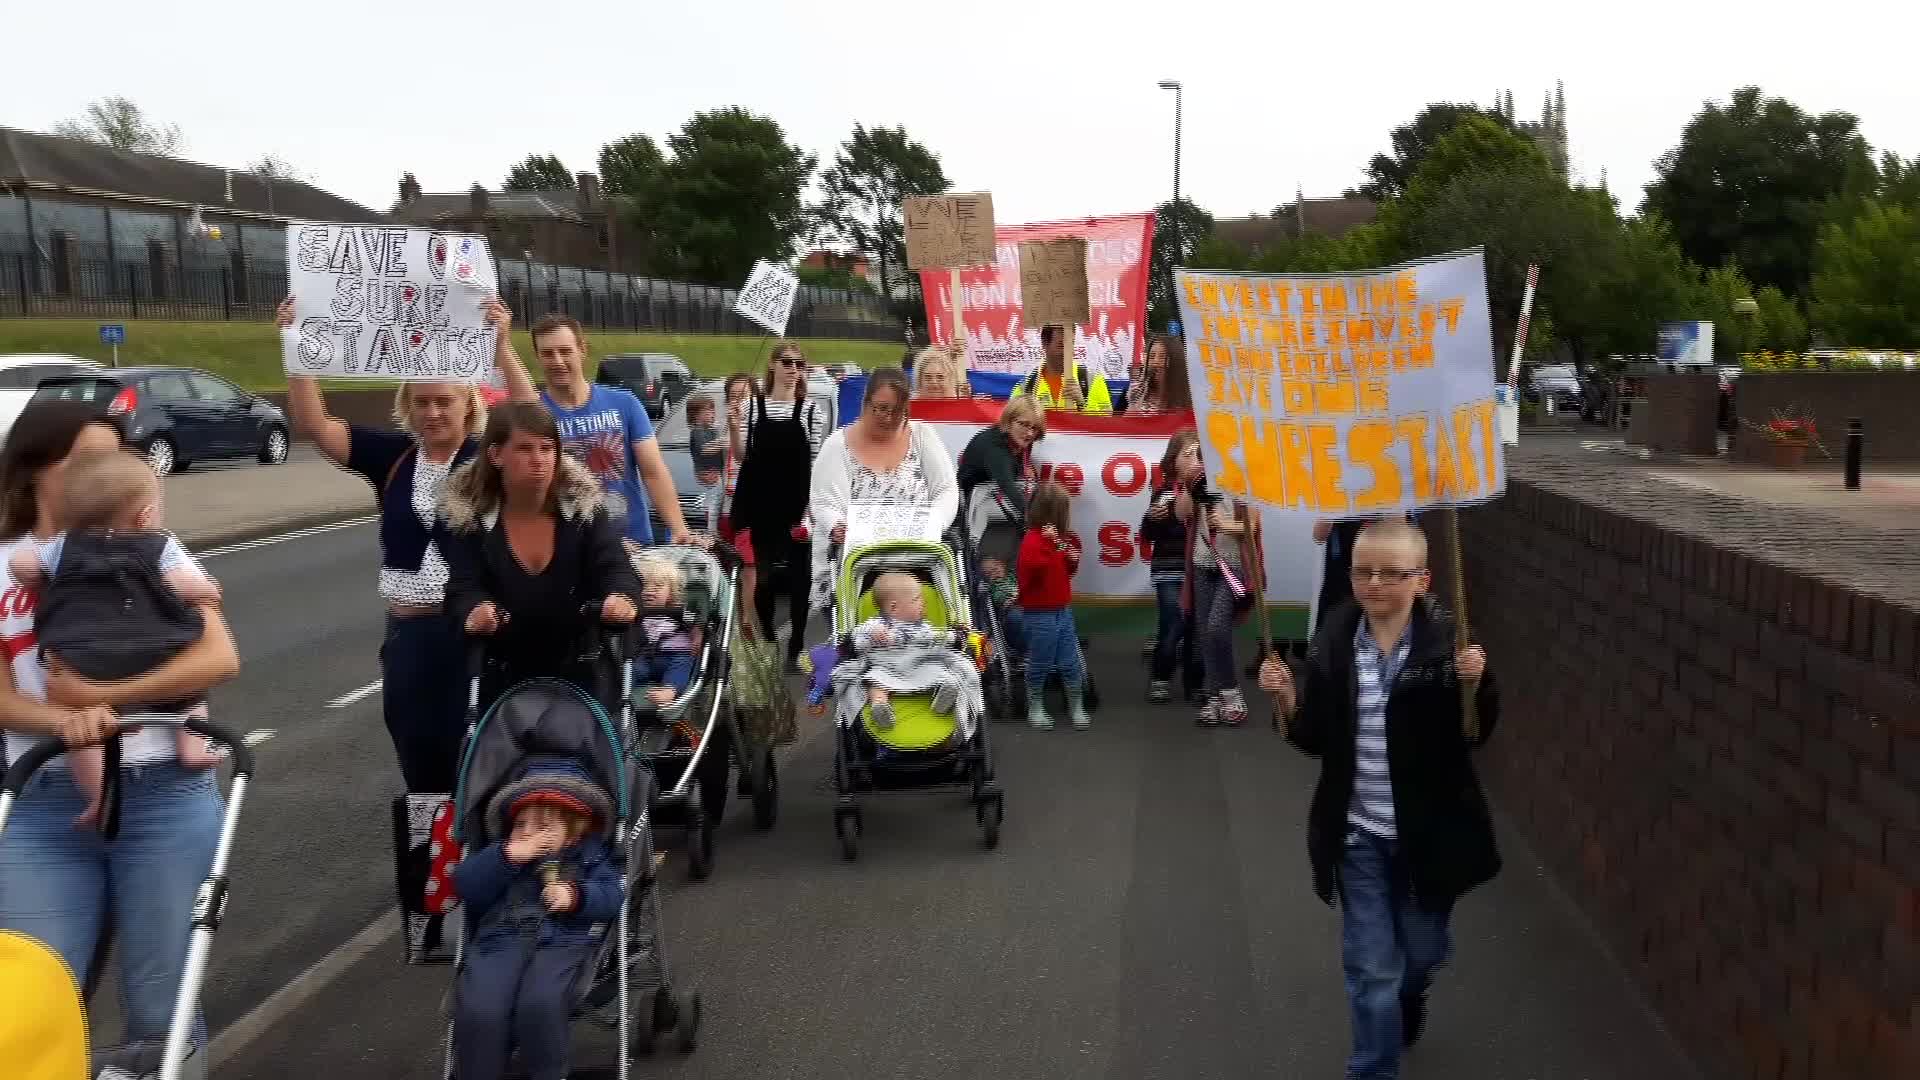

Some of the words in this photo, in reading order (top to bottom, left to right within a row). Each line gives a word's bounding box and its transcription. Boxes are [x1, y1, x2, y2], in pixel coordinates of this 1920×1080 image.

[913, 199, 979, 219] WE
[298, 226, 407, 277] SAVE
[331, 274, 448, 328] SURE
[939, 283, 1009, 311] UION
[1184, 275, 1290, 316] INVEST
[1206, 369, 1273, 411] SAVE
[1206, 411, 1346, 510] SURE
[1348, 403, 1497, 510] START
